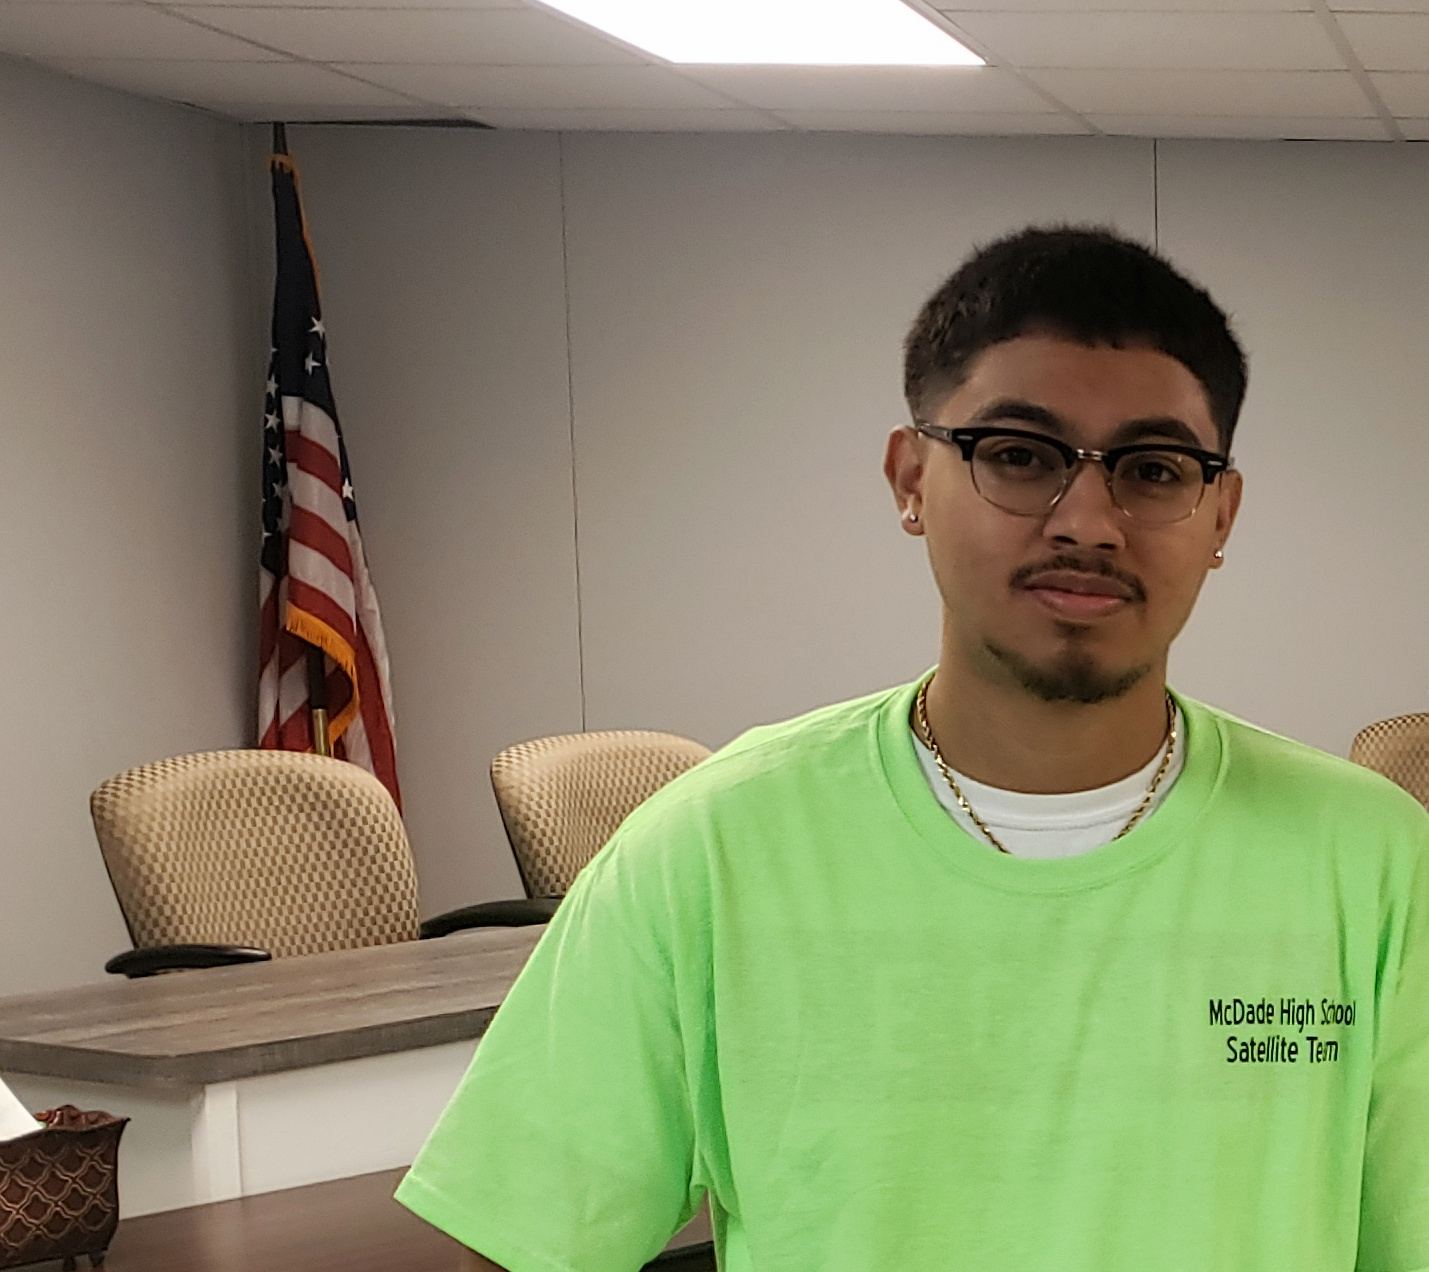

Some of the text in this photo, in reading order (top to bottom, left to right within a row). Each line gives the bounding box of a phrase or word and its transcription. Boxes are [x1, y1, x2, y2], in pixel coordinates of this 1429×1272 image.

[1209, 998, 1275, 1026] McDade
[1280, 997, 1315, 1033] High
[1226, 1035, 1298, 1063] Satellite
